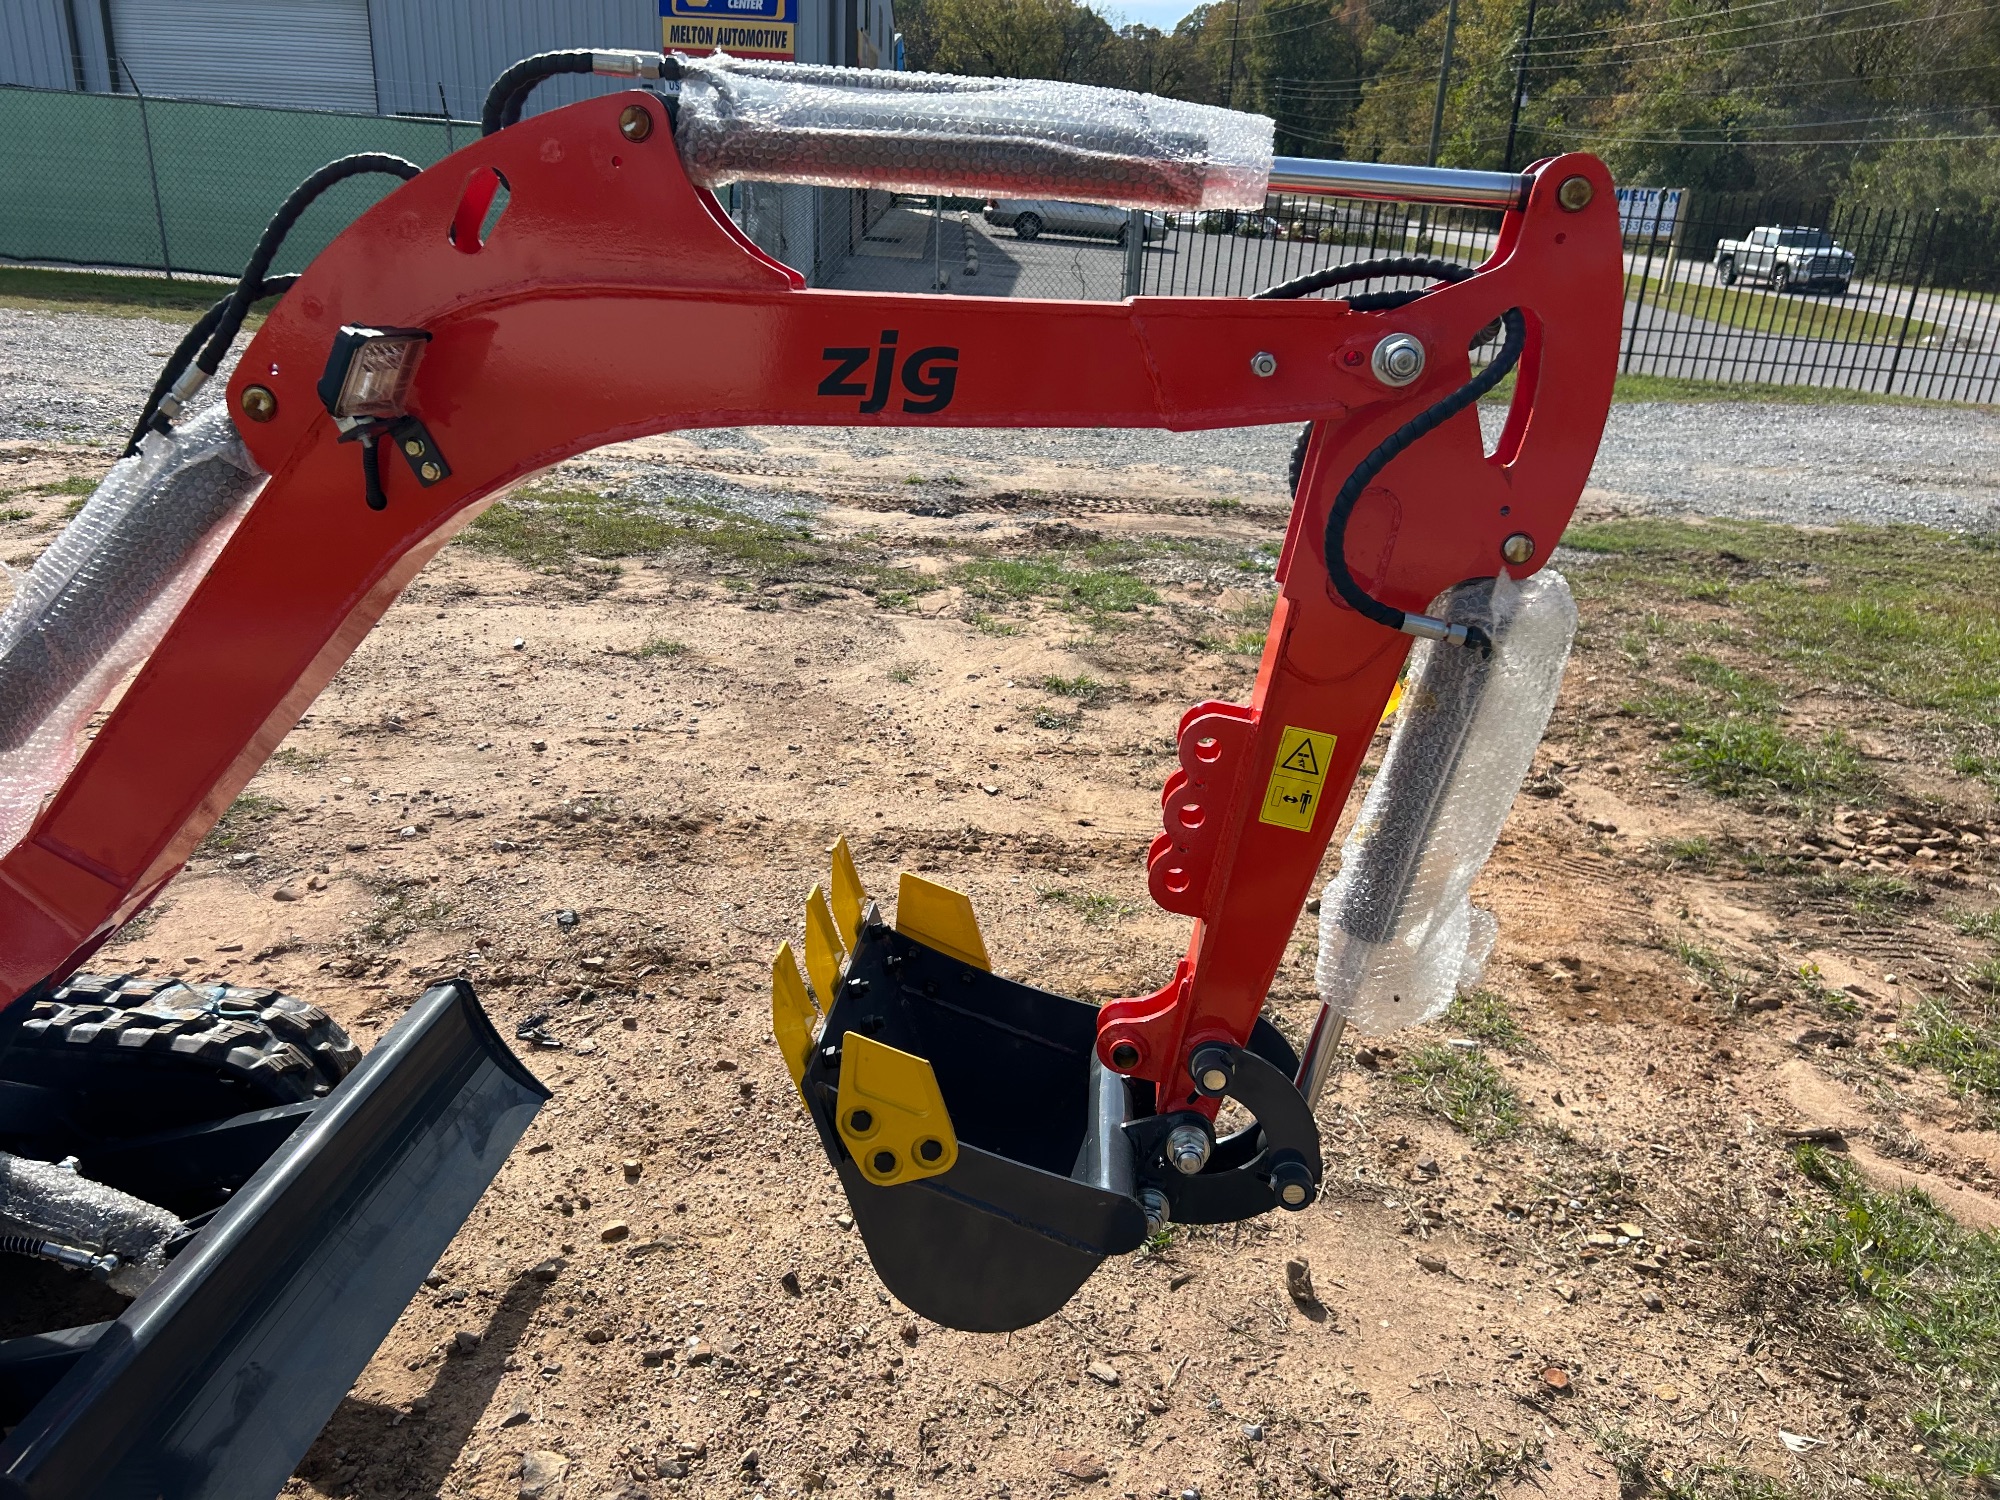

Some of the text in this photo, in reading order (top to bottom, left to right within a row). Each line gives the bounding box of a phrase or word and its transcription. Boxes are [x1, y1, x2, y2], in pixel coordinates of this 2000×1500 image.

[728, 0, 763, 10] CENTER
[670, 25, 788, 48] MELTON AUTOMOTIVE
[669, 81, 682, 91] US
[1616, 190, 1681, 203] MELTN
[817, 329, 960, 415] zjg
